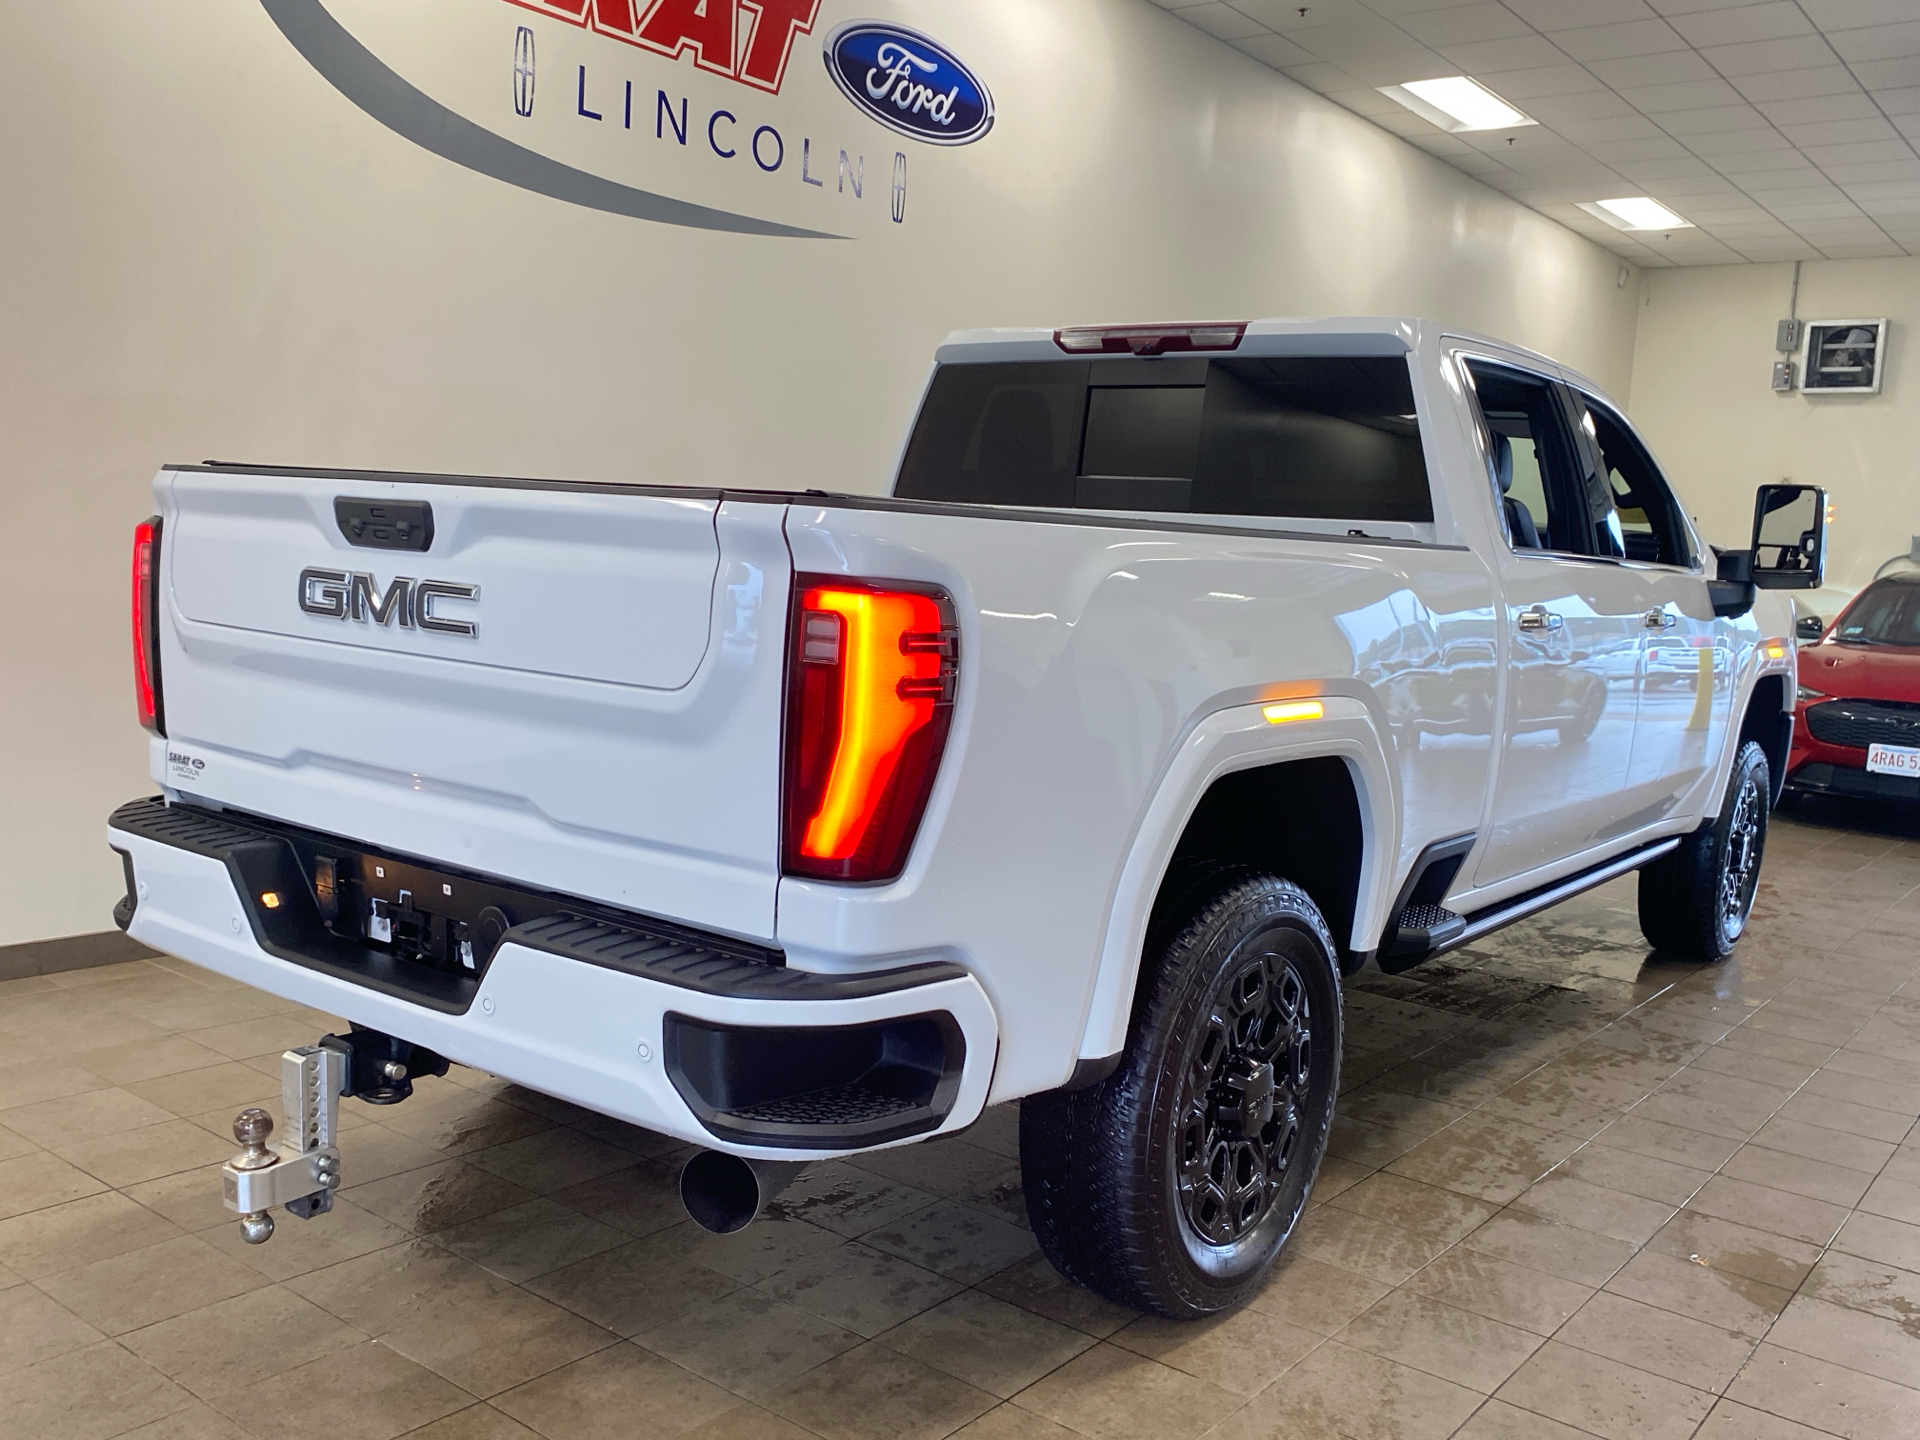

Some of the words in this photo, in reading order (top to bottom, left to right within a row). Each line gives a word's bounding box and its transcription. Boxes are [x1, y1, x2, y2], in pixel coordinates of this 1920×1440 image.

[866, 42, 959, 125] Ford
[577, 65, 864, 199] LINCOLN
[299, 565, 481, 640] GMC
[172, 764, 200, 776] LINCOLN
[1870, 751, 1906, 767] 4RAG
[1909, 755, 1920, 770] 5
